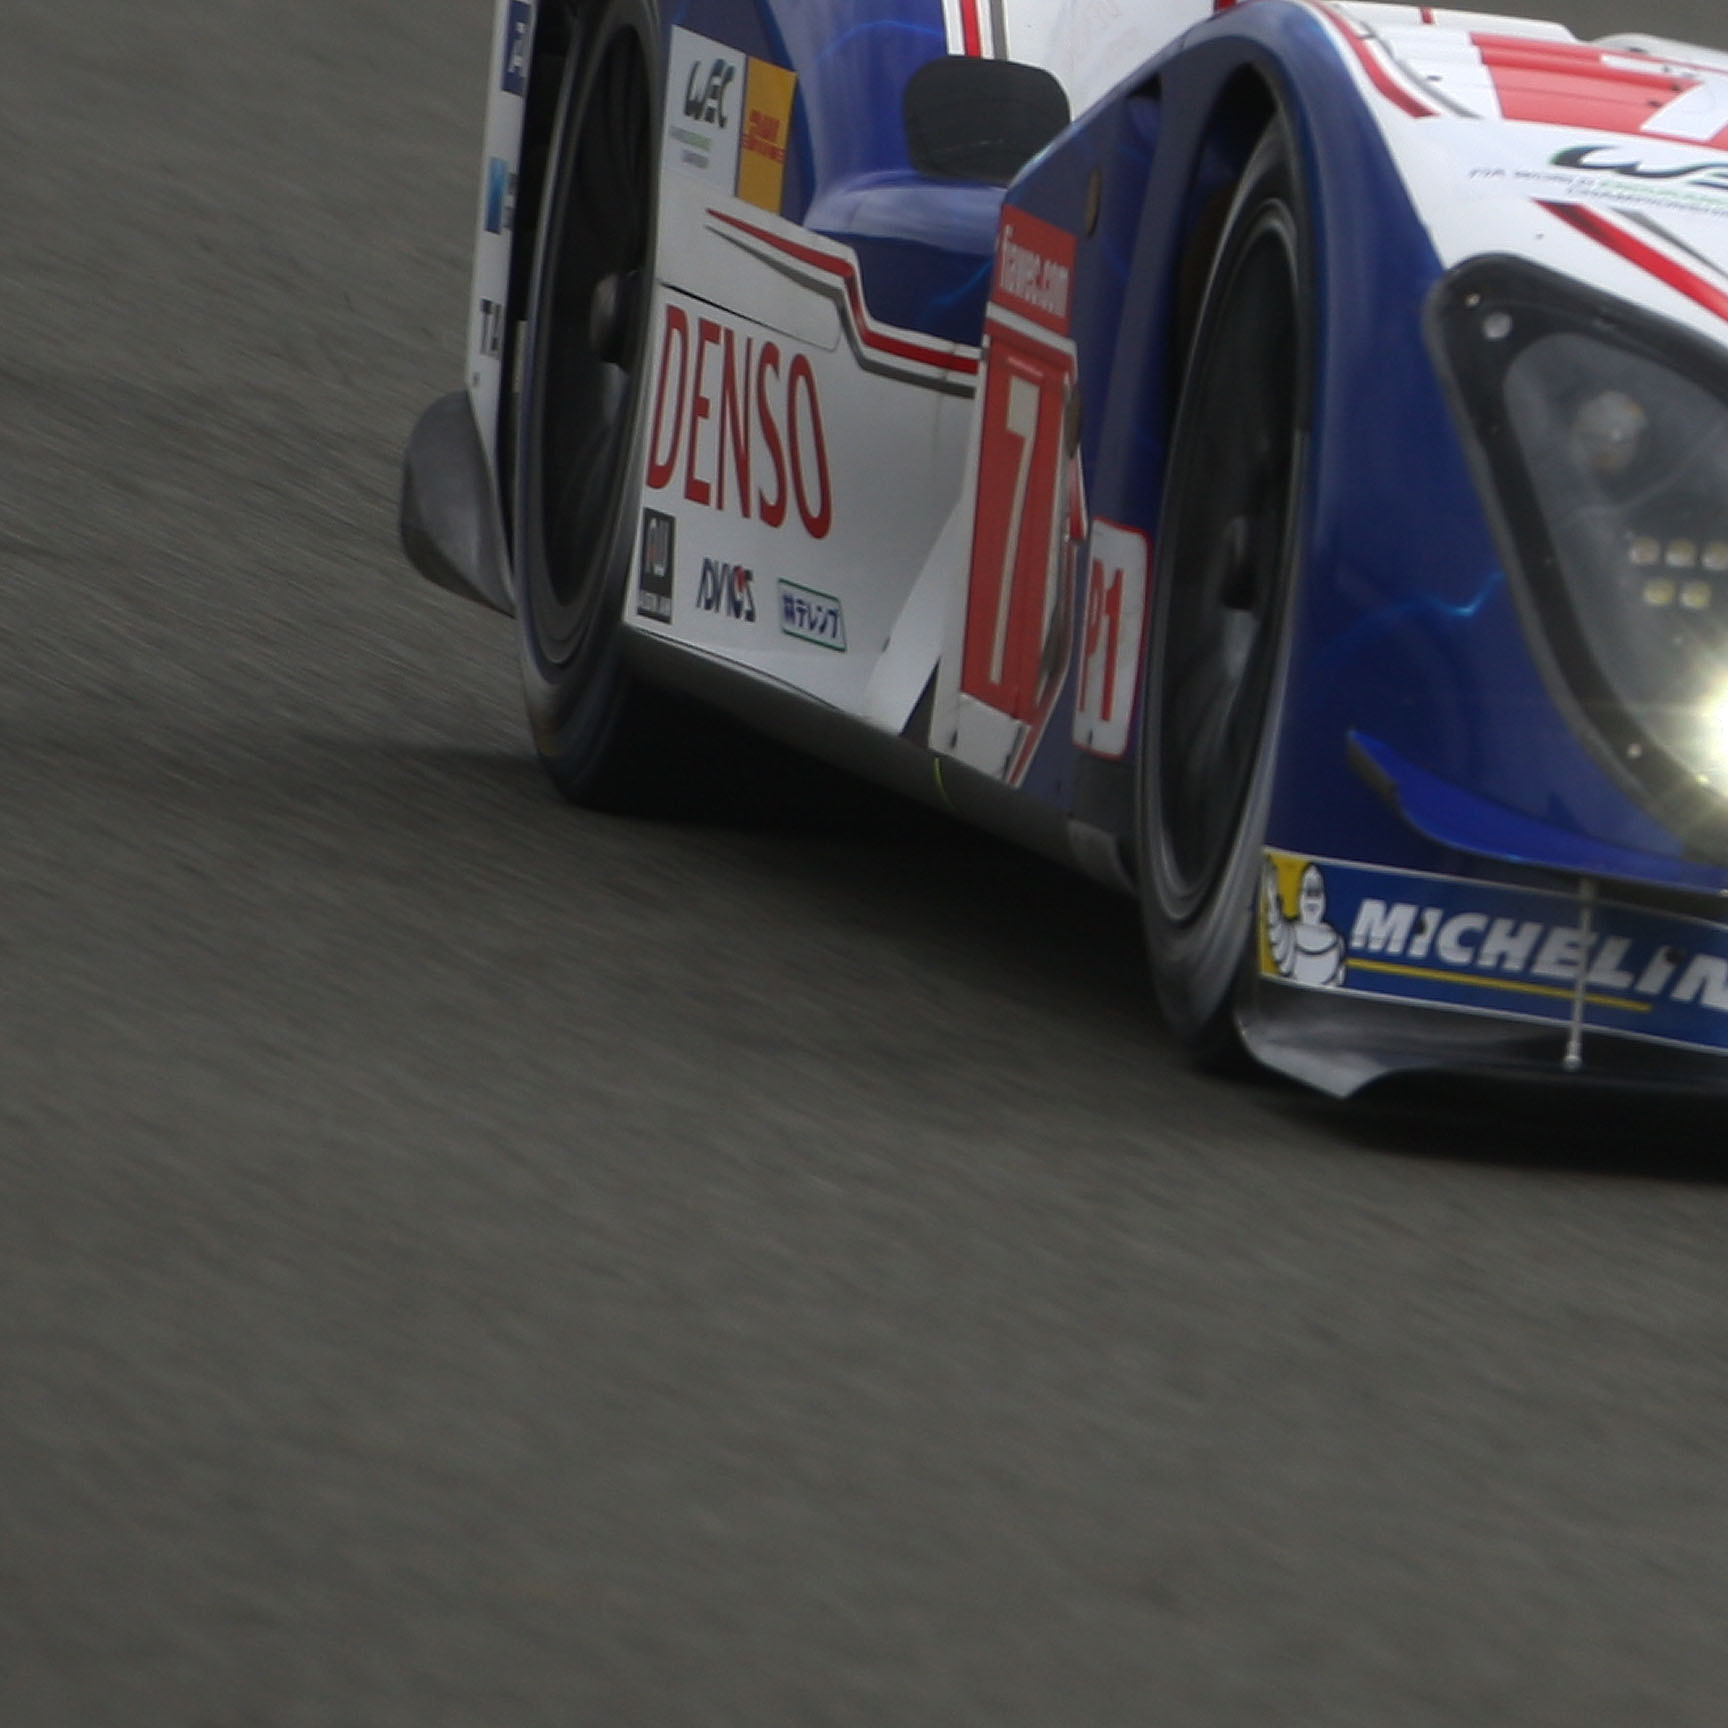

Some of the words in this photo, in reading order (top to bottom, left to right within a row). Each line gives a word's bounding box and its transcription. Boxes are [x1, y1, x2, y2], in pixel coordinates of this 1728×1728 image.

[646, 304, 832, 540] DENSO
[989, 375, 1041, 686] 7
[1078, 558, 1125, 723] P1
